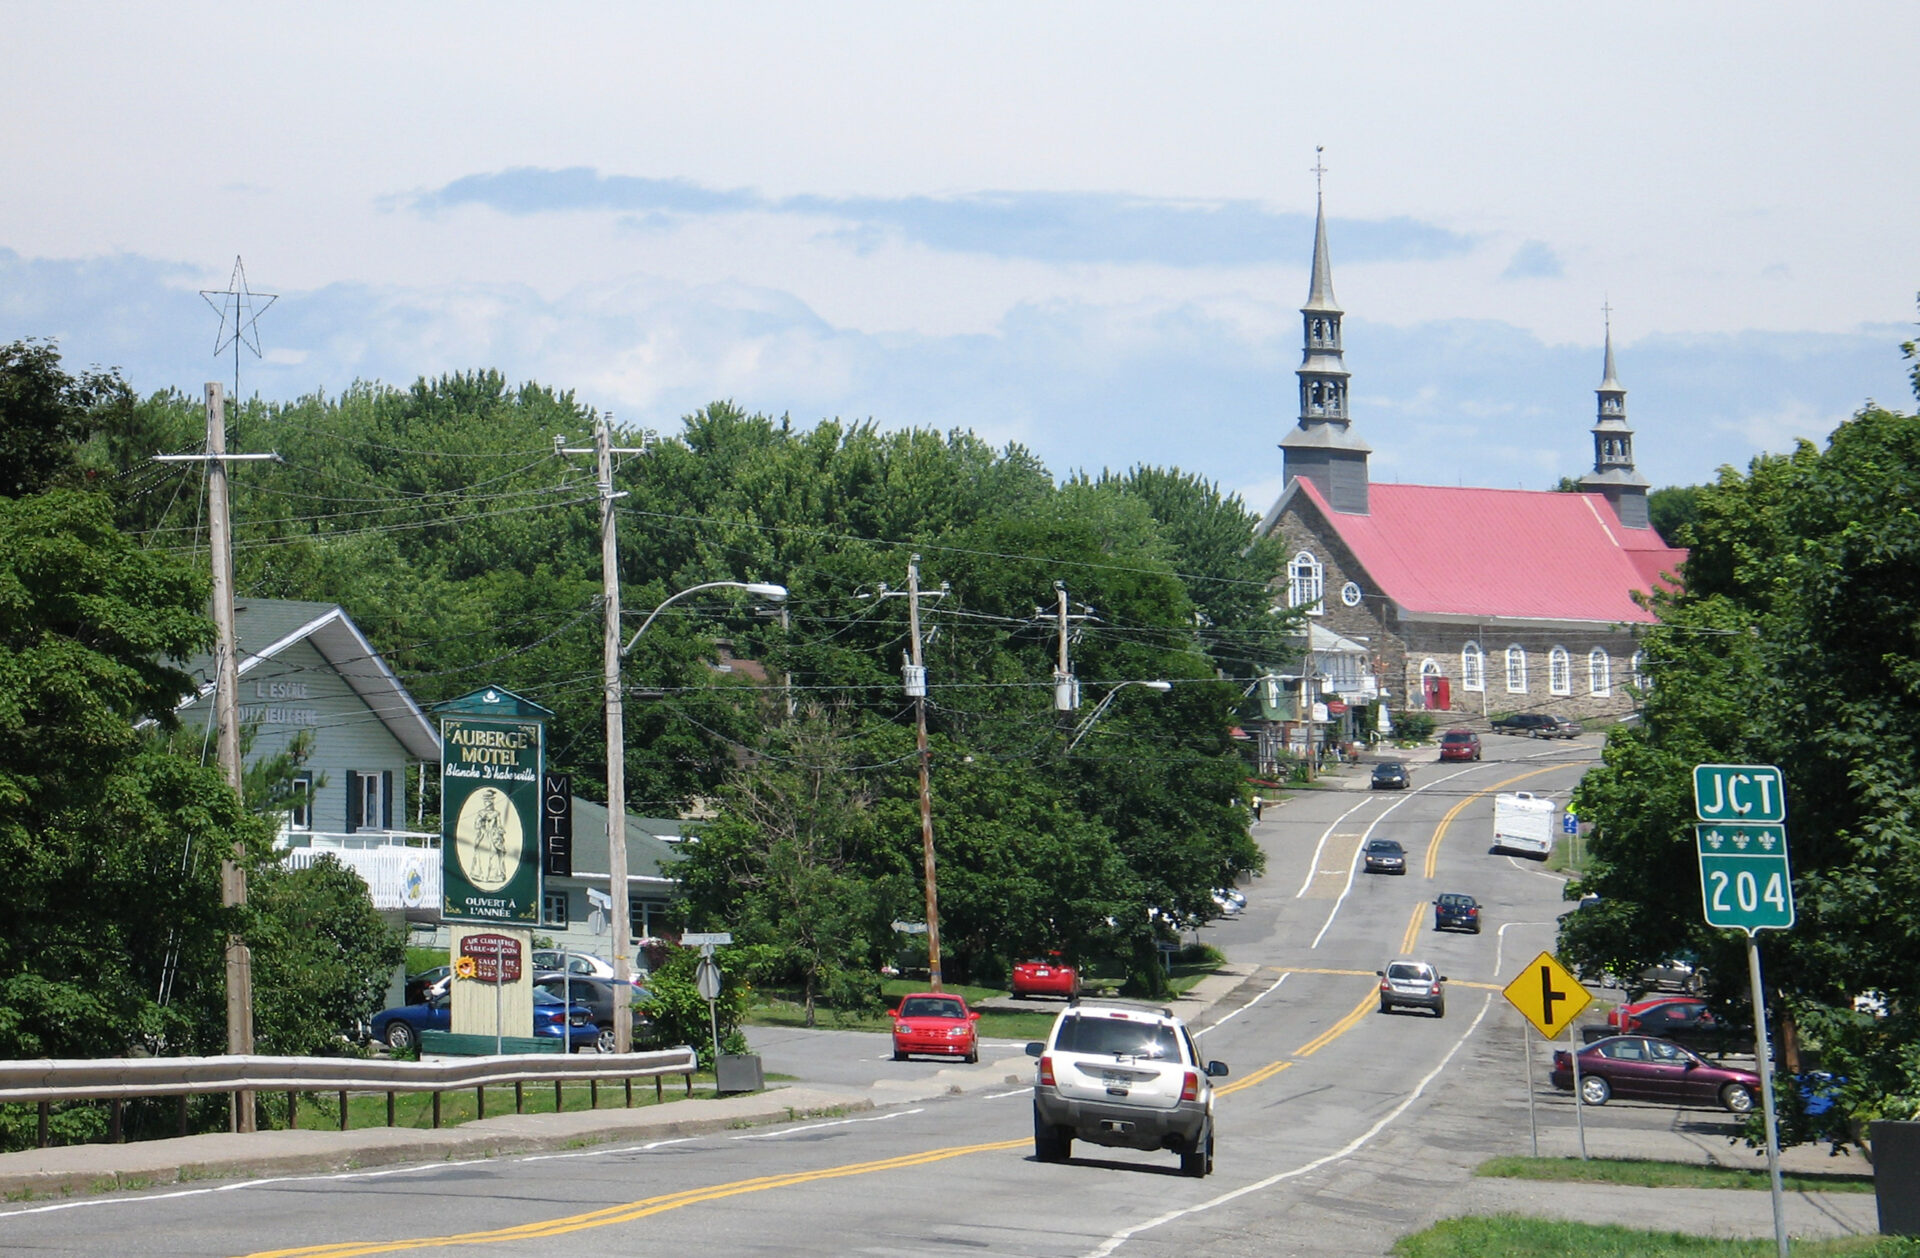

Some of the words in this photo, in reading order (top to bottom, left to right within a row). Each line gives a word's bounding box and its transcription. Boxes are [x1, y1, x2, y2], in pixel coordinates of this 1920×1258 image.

[451, 729, 528, 749] AUBERGE
[462, 747, 520, 766] MOTEL
[445, 763, 481, 778] Blanche
[1703, 773, 1775, 814] JCT
[546, 776, 567, 874] MOTEL
[1710, 870, 1785, 912] 204
[465, 897, 507, 907] OUVERT
